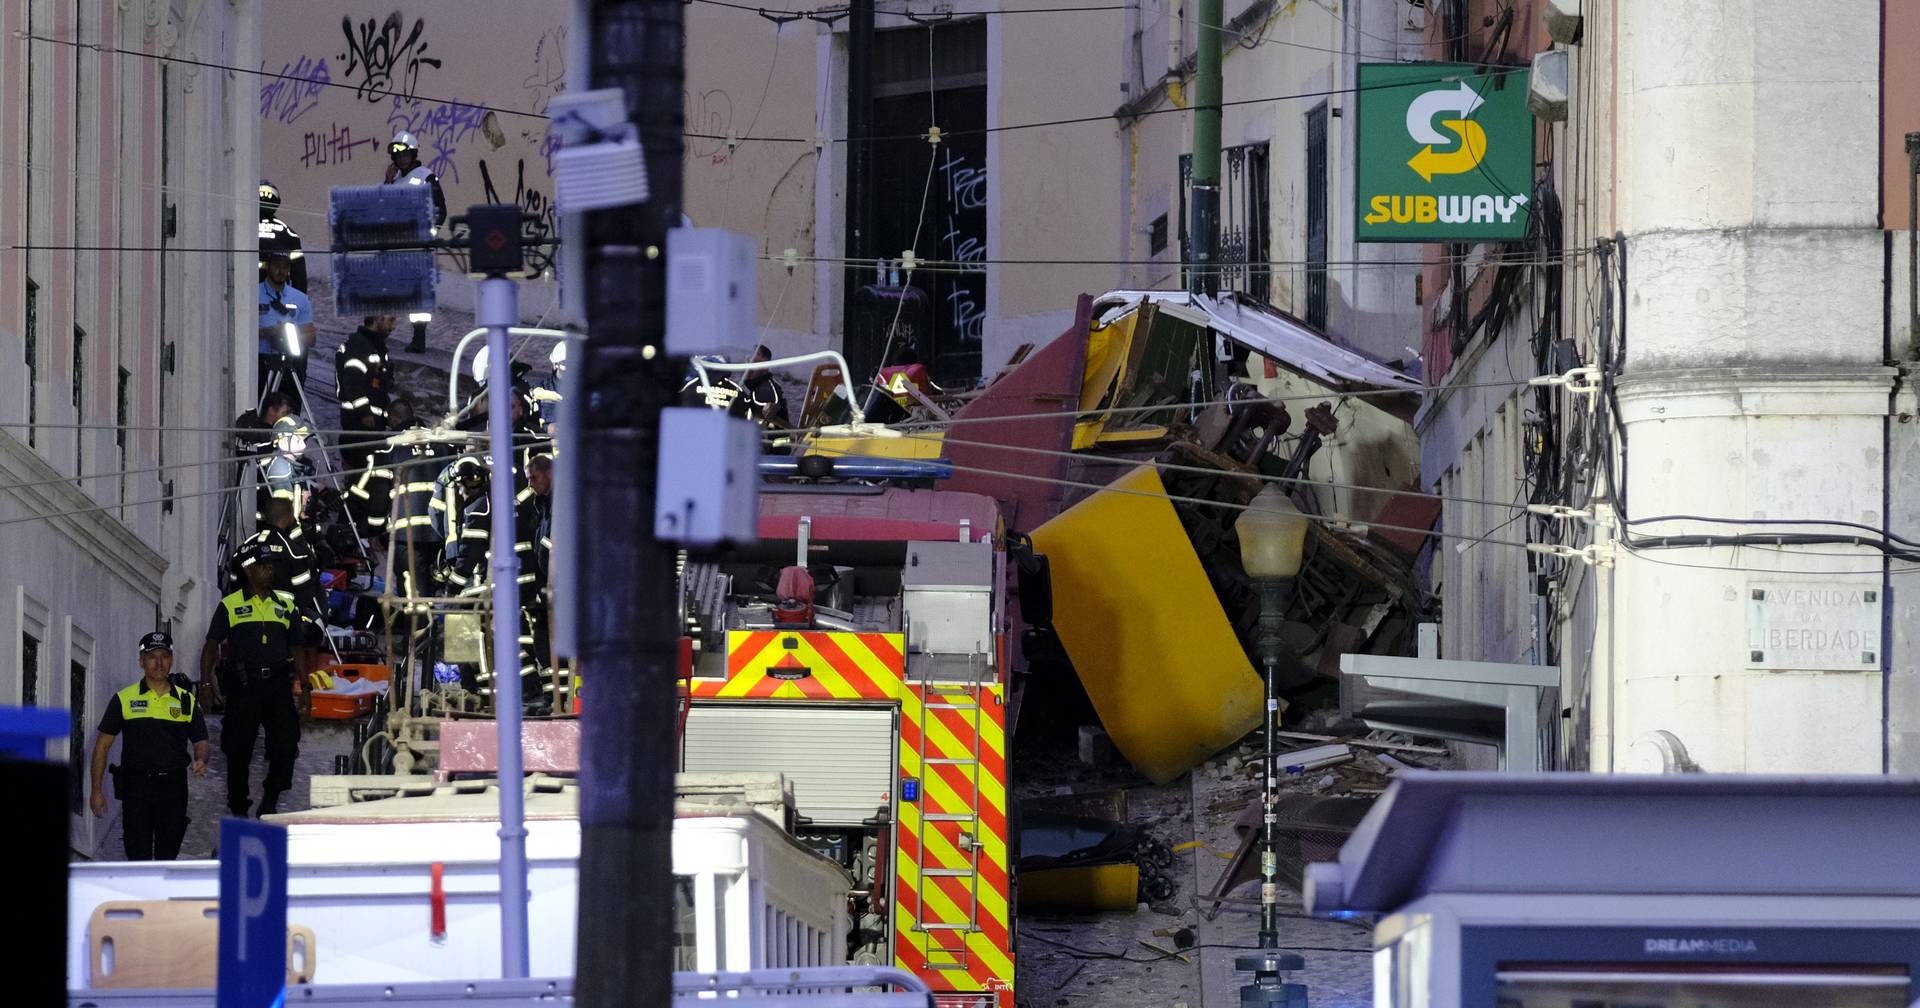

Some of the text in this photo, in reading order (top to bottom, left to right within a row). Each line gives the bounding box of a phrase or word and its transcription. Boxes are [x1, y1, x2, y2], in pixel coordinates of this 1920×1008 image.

[1364, 193, 1529, 225] SUBWAY
[1763, 589, 1864, 607] AVENIDA
[1748, 628, 1877, 650] LIBERDADE
[238, 834, 270, 961] P
[1644, 938, 1758, 951] DREAMMEDIA
